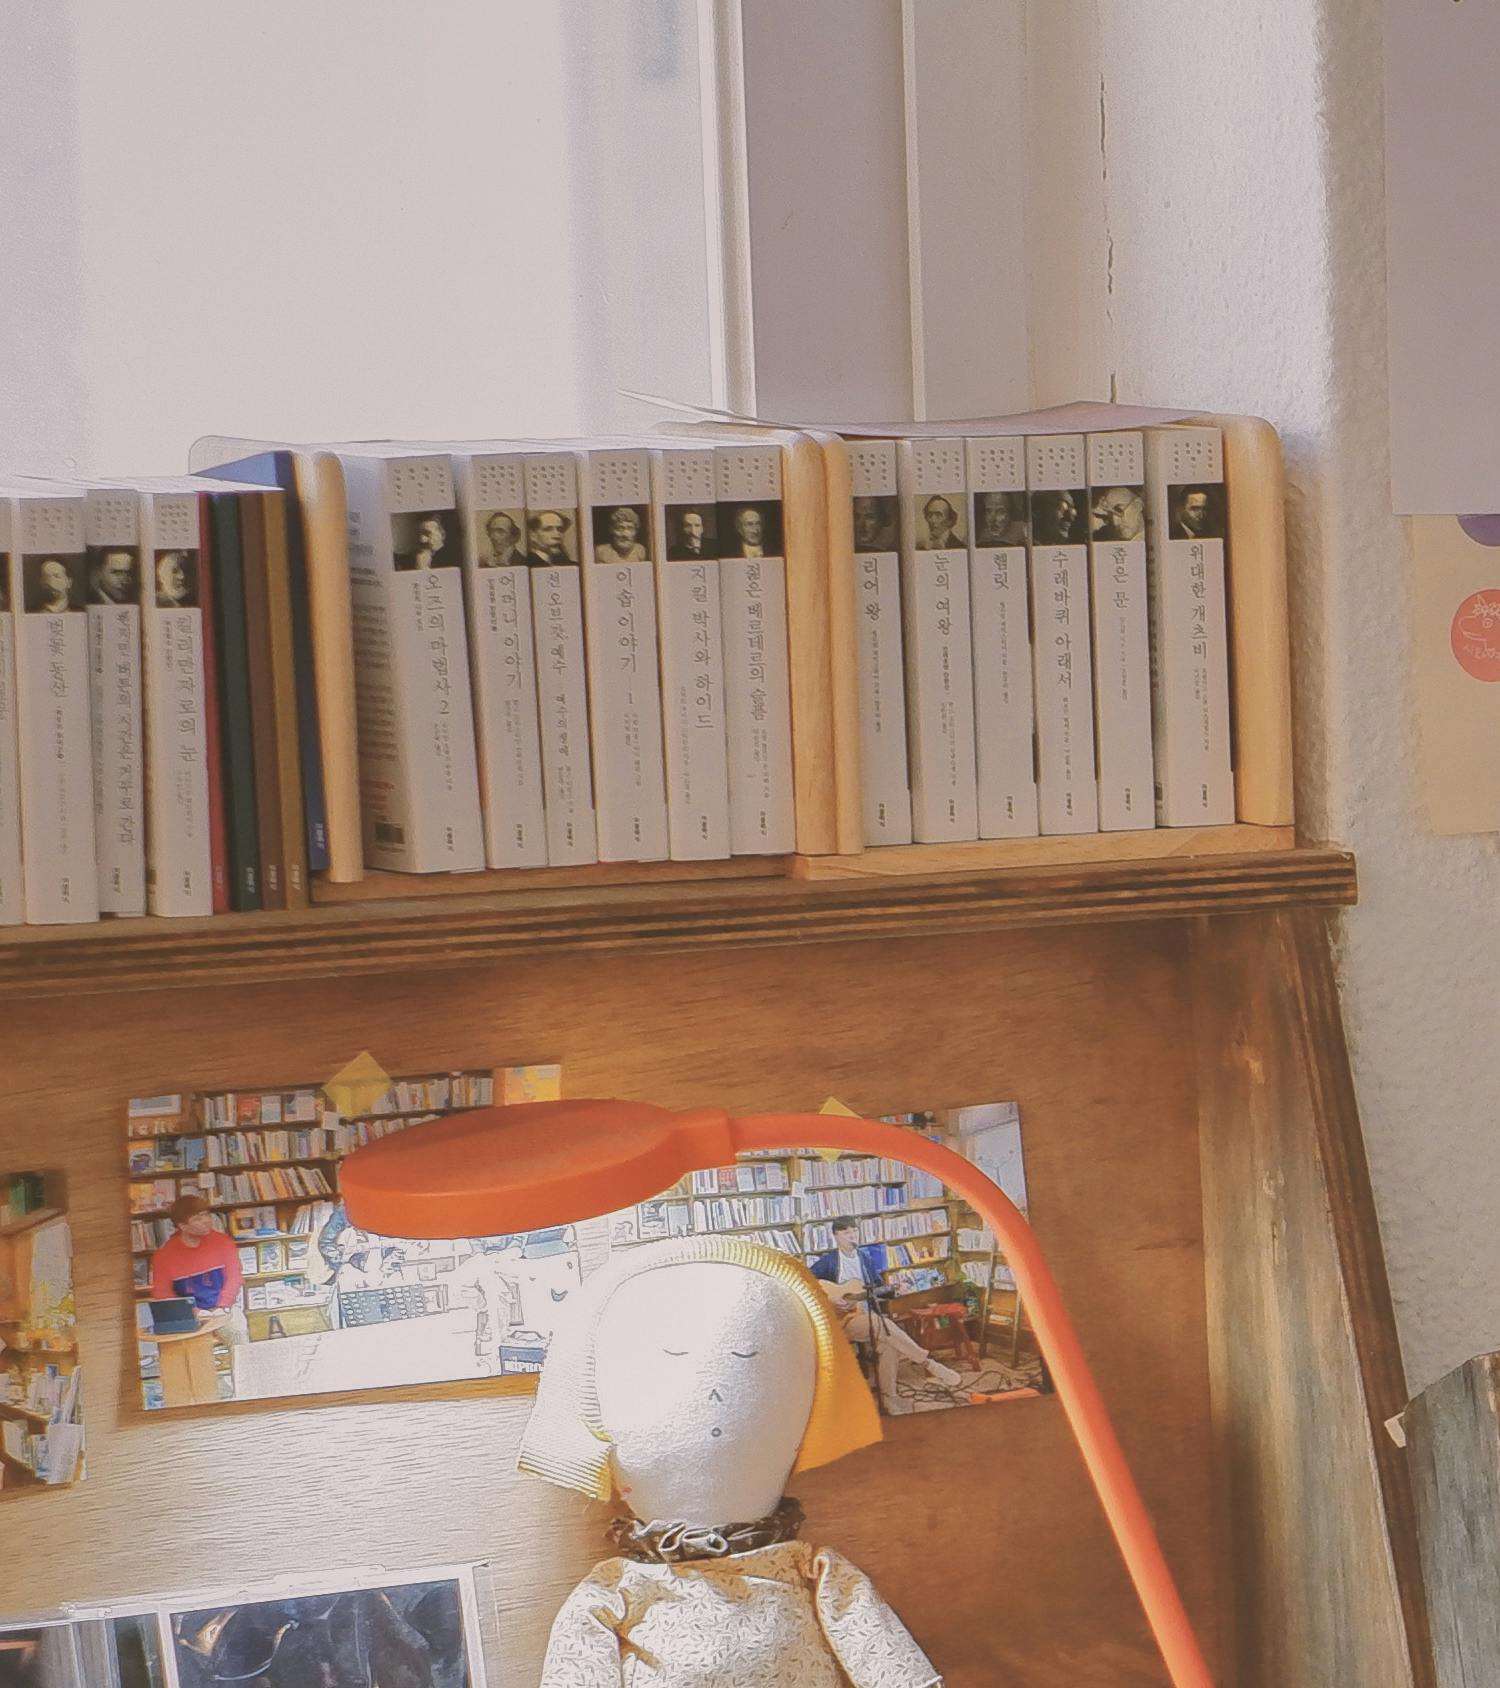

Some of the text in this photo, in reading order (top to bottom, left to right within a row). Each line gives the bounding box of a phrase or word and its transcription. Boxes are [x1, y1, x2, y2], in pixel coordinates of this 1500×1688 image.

[1052, 550, 1072, 689] 수레바퀴 아래서
[1112, 548, 1129, 608] 좁은 문
[1190, 544, 1208, 659] 위대한 개츠비
[696, 674, 714, 729] 하이드
